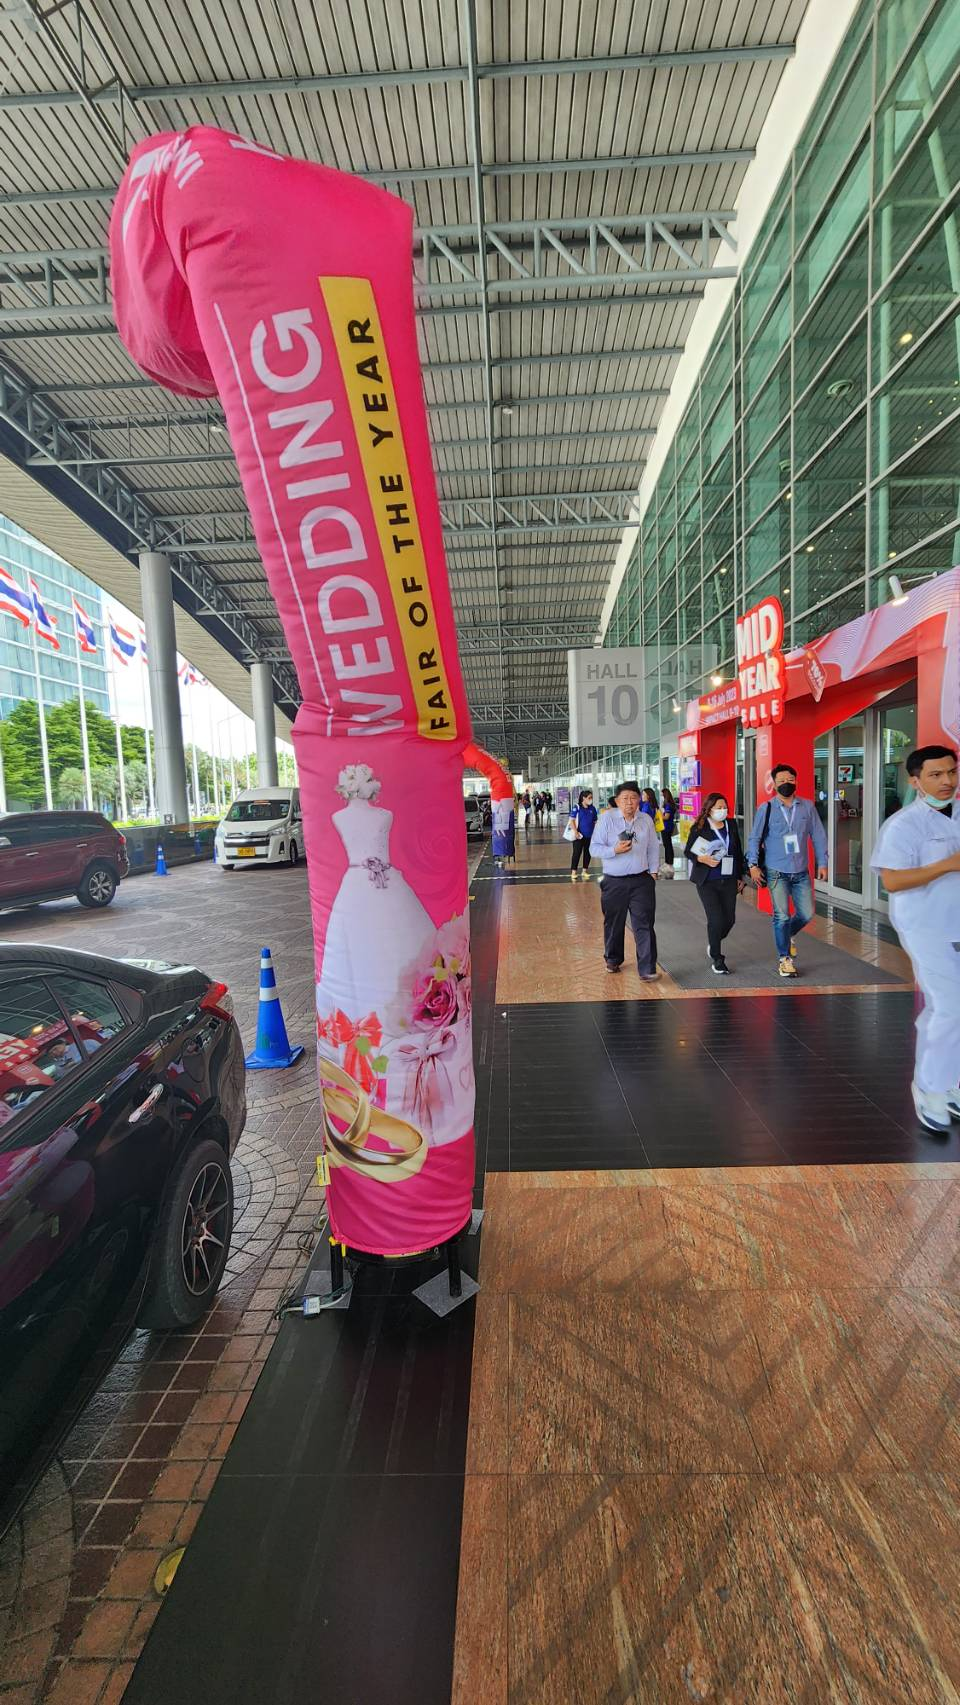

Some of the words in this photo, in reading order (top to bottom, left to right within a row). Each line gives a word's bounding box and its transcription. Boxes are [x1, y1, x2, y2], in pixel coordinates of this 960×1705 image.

[348, 317, 394, 448] YEAR
[250, 308, 405, 737] WEDDING
[379, 474, 415, 554] THE
[402, 577, 428, 627] OF
[736, 604, 779, 666] MID
[419, 648, 450, 730] FAIR
[587, 663, 638, 679] HALL
[739, 656, 781, 700] YEAR
[587, 684, 639, 727] 10
[741, 700, 780, 723] SALE
[535, 763, 549, 776] 11
